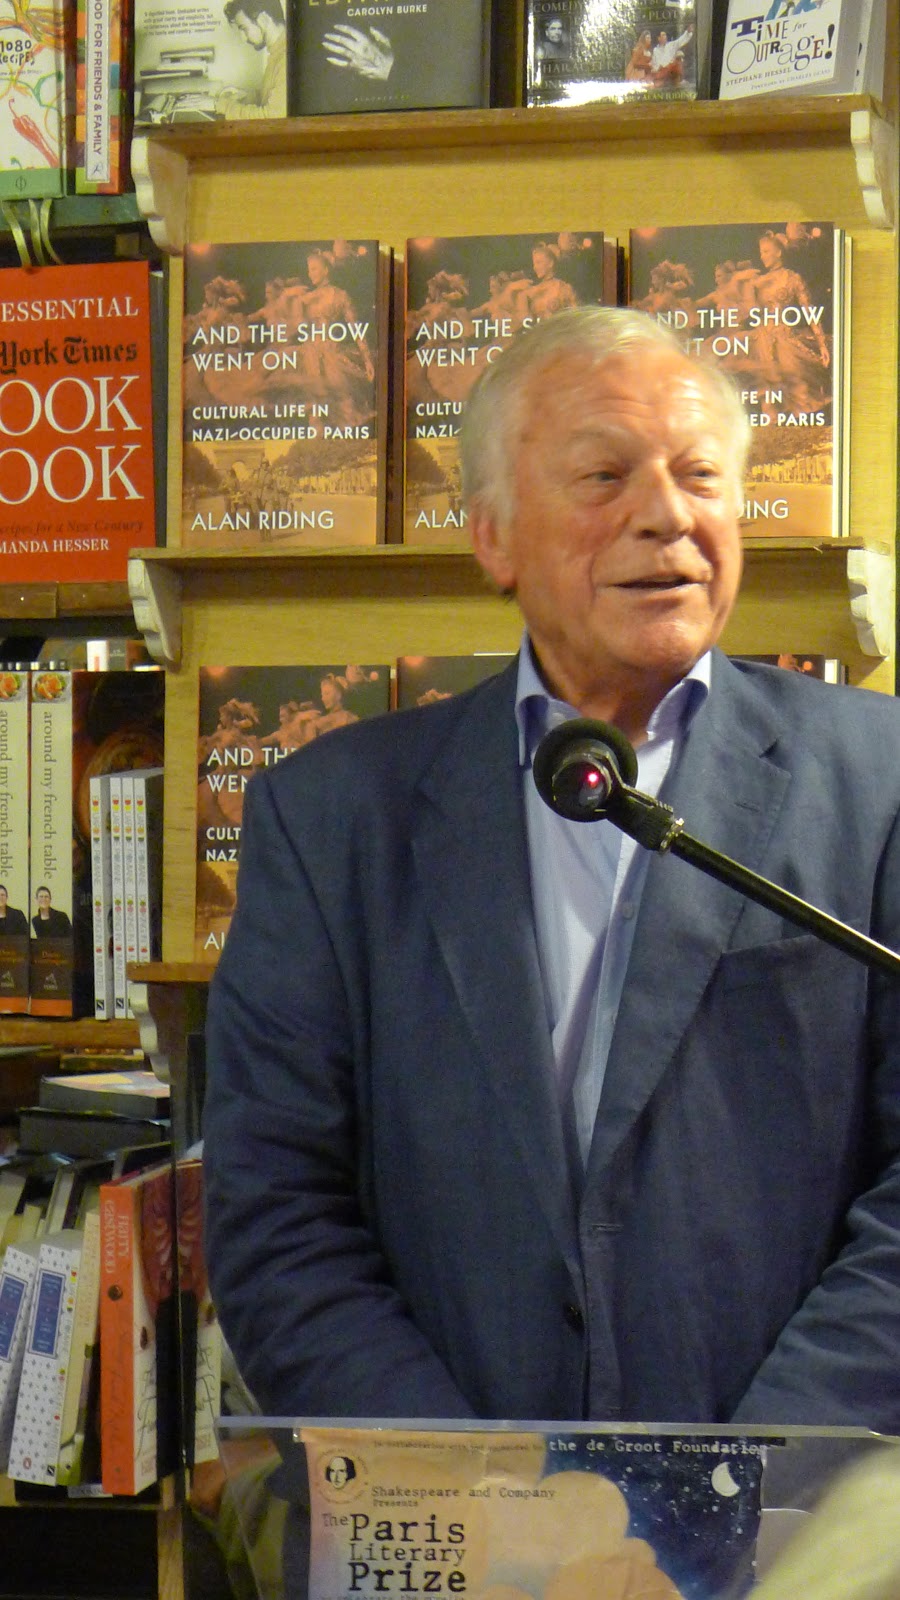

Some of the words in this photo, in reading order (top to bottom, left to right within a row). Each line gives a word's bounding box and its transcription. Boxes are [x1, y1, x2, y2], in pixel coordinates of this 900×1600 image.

[347, 6, 393, 16] CAROLYN
[396, 4, 428, 14] BURKE
[93, 23, 103, 47] FOR
[793, 22, 807, 33] for
[0, 39, 32, 52] 1080
[93, 51, 103, 100] FRIENDS
[726, 72, 763, 86] STEPHANE
[764, 67, 791, 78] HESSEL
[93, 103, 102, 112] &
[93, 114, 102, 155] FAMILY
[1, 296, 139, 322] ESSENTIAL
[657, 310, 689, 330] ND
[696, 308, 739, 329] THE
[748, 305, 825, 327] SHOW
[192, 325, 241, 345] AND
[248, 323, 288, 344] THE
[297, 322, 370, 343] SHOW
[415, 320, 464, 341] AND
[471, 318, 514, 339] THE
[0, 338, 58, 375] York
[63, 336, 138, 364] Times
[712, 335, 749, 357] ON
[192, 352, 255, 372] WENT
[262, 351, 298, 371] ON
[415, 347, 479, 368] WENT
[765, 390, 783, 404] IN
[192, 404, 268, 420] CULTURAL
[274, 404, 306, 418] LIFE
[312, 403, 329, 417] IN
[416, 401, 462, 417] CULTU
[777, 412, 826, 427] PARIS
[192, 426, 317, 442] NAZI-OCCUPIED
[323, 426, 370, 440] PARIS
[191, 511, 250, 531] ALAN
[259, 510, 334, 530] RIDING
[53, 538, 110, 553] HESSER
[0, 711, 12, 761] around
[43, 711, 57, 763] around
[206, 747, 254, 767] AND
[261, 747, 298, 767] TH
[40, 768, 53, 789] my
[0, 792, 13, 837] french
[43, 793, 57, 840] french
[0, 842, 13, 877] table
[43, 844, 57, 880] table
[550, 1438, 577, 1451] the
[586, 1438, 606, 1451] de
[615, 1439, 662, 1452] Groot
[371, 1486, 460, 1501] Shakespeare
[468, 1486, 490, 1498] and
[499, 1486, 555, 1501] Company
[322, 1513, 349, 1527] The
[350, 1513, 465, 1544] Paris
[350, 1543, 467, 1567] Literary
[348, 1562, 467, 1593] Prize
